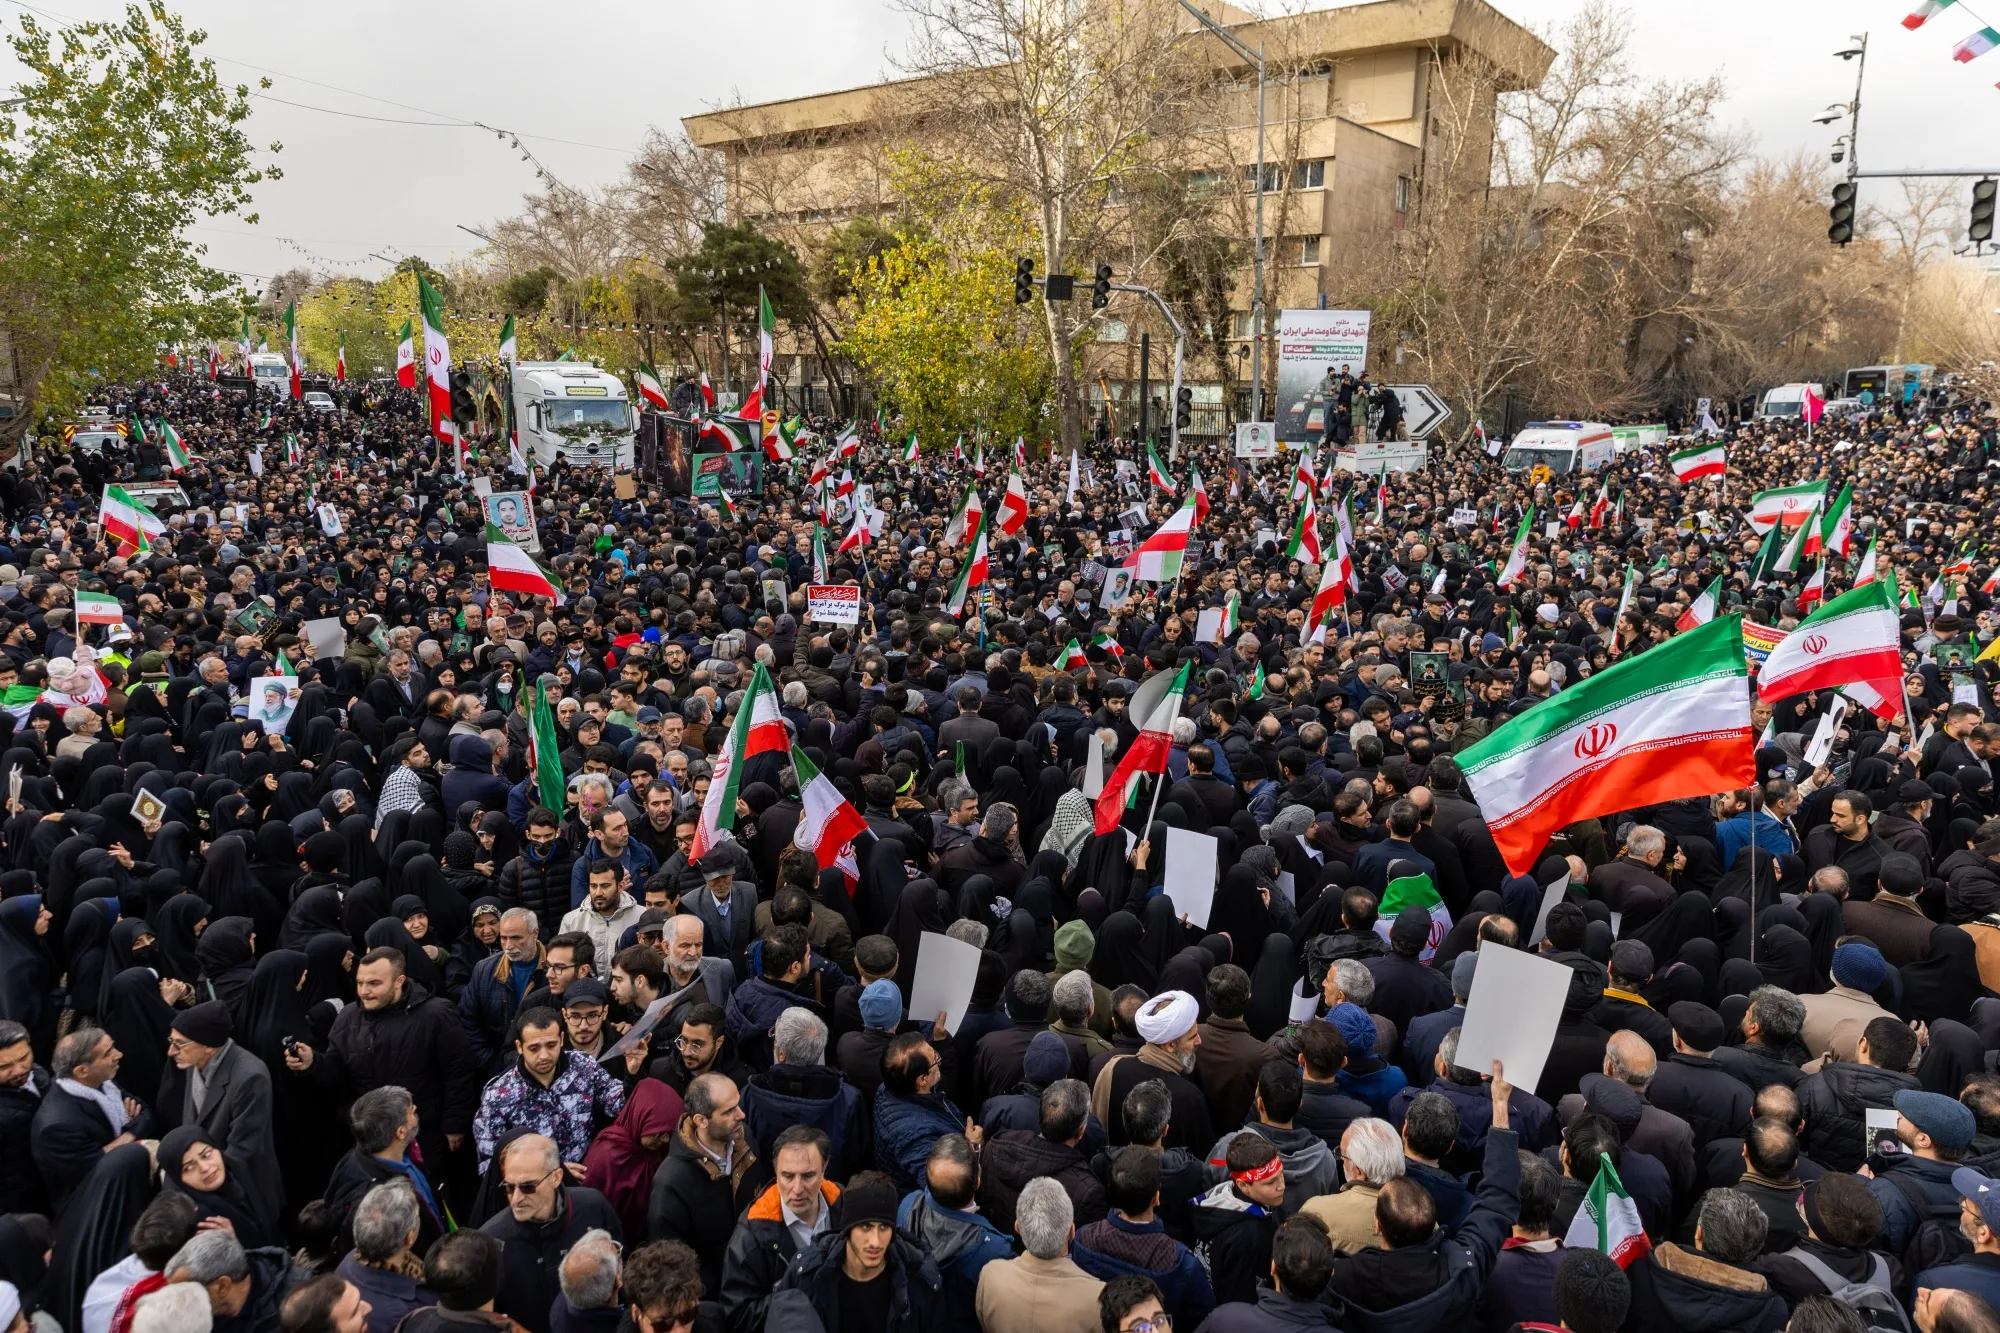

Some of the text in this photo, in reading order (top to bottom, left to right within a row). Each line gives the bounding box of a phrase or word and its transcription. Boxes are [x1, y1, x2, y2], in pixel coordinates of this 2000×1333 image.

[1283, 327, 1366, 336] شهدای مقاومت ملی ایران
